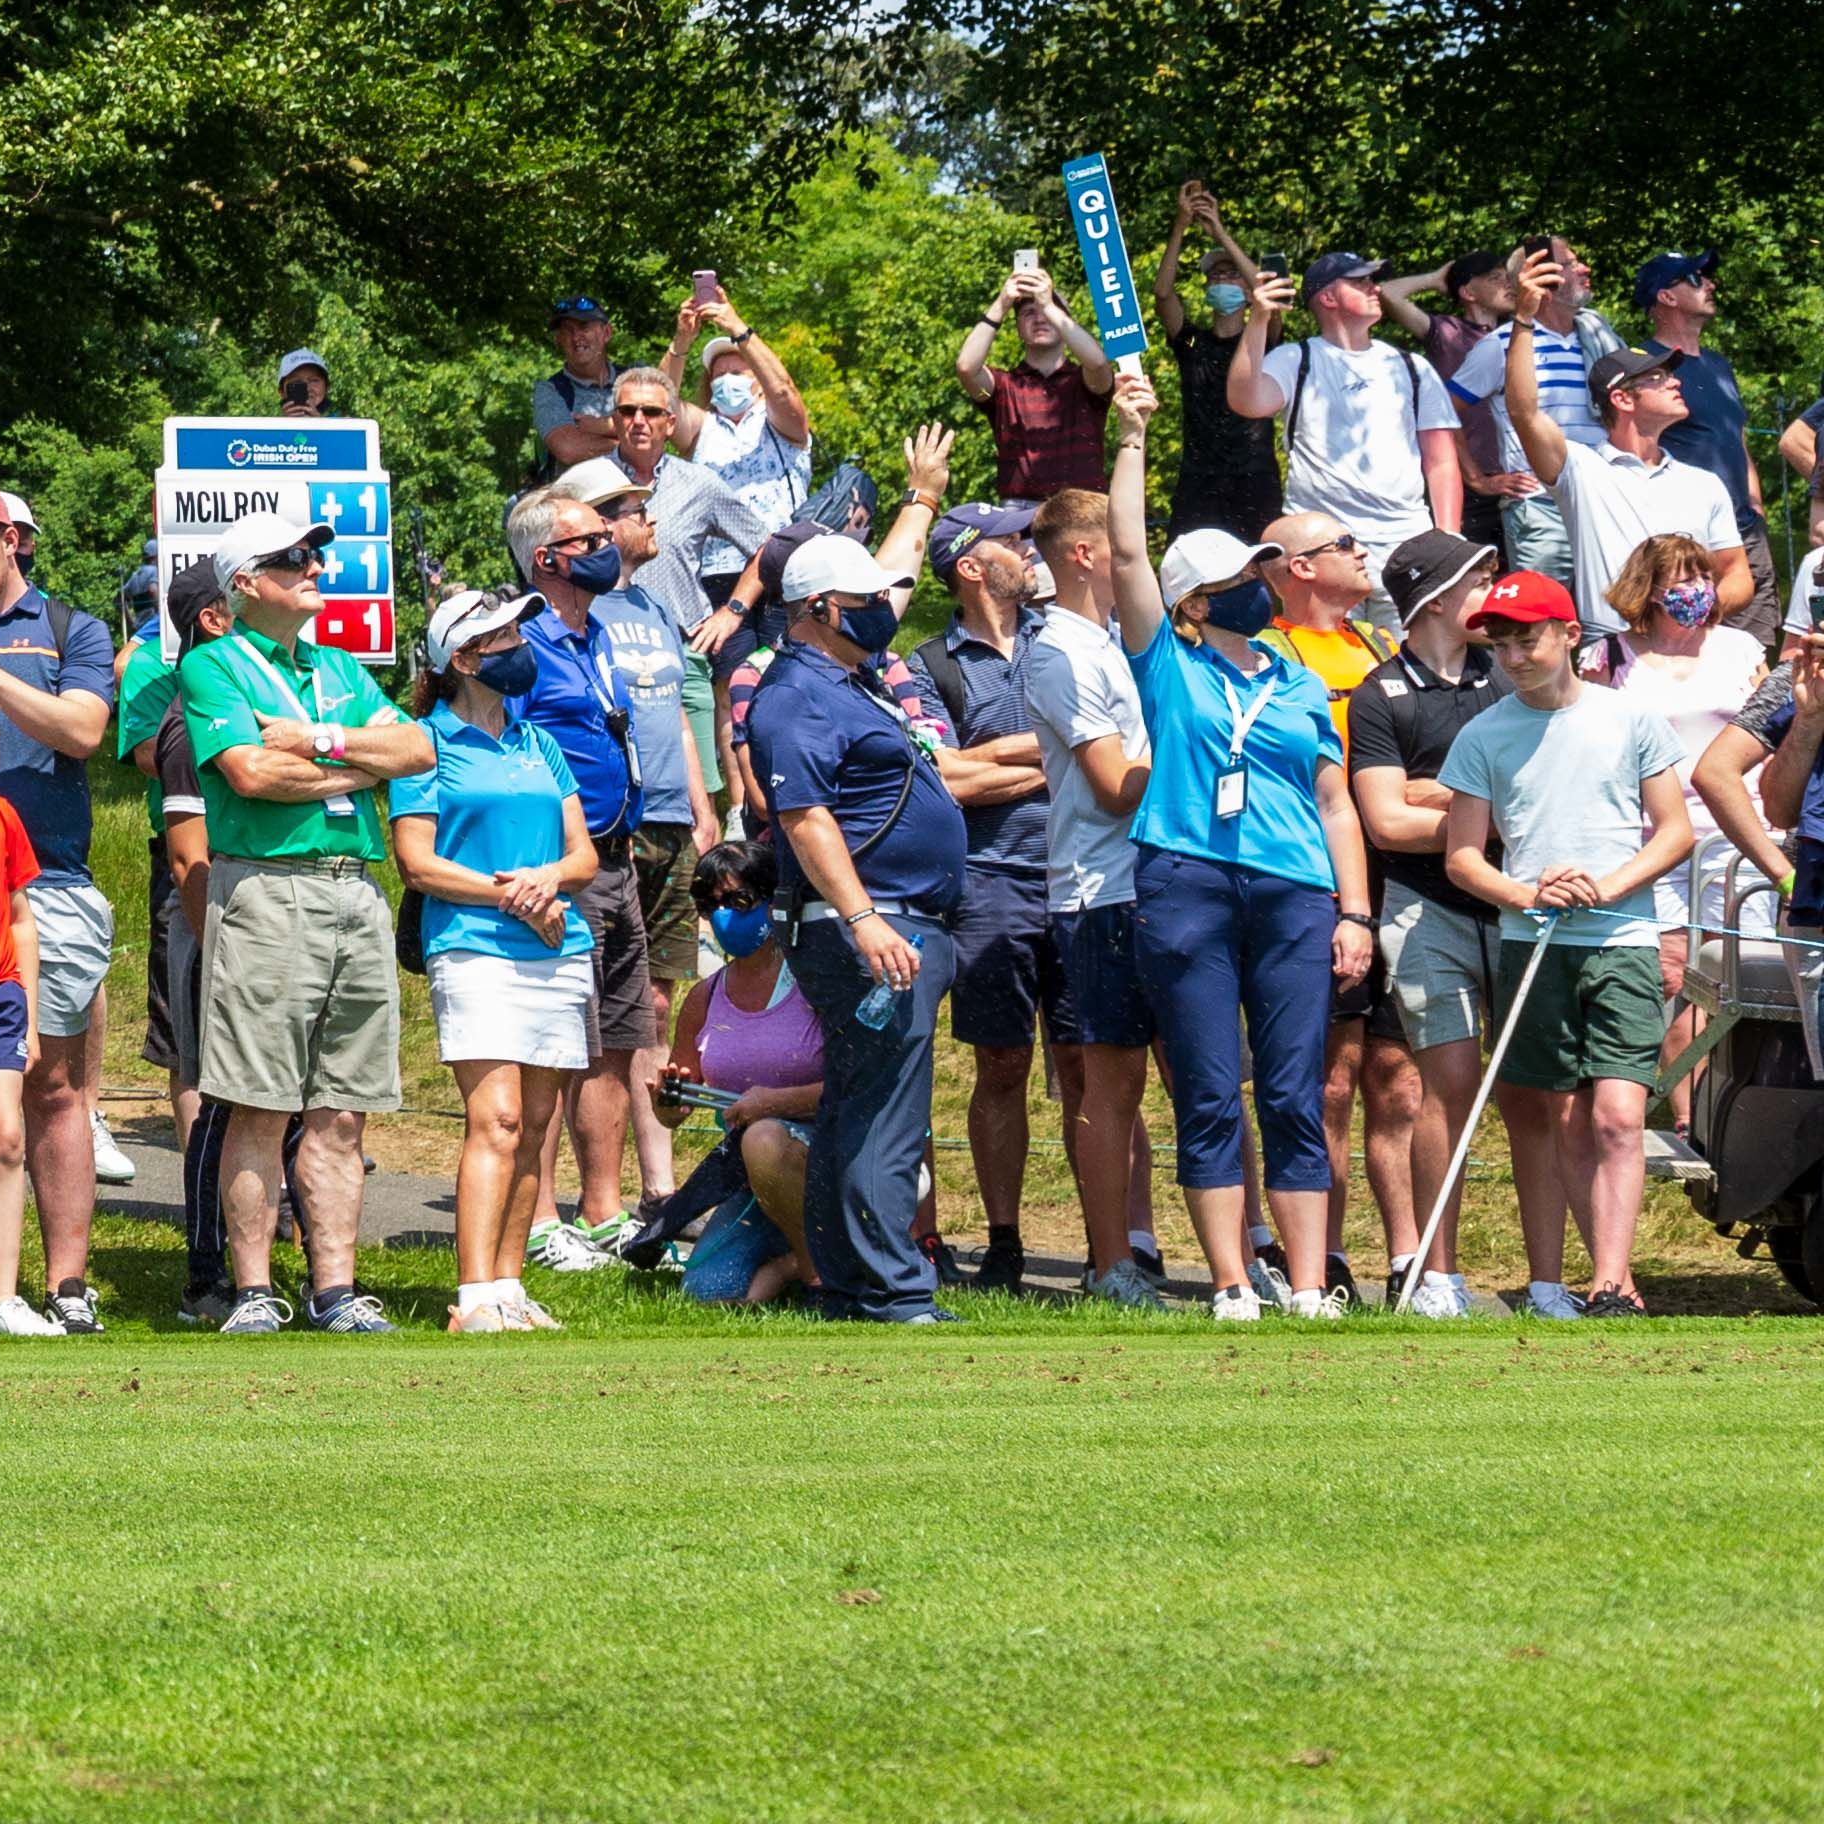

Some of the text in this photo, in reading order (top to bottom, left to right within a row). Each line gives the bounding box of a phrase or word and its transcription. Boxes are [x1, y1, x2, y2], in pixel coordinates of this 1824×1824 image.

[1078, 189, 1124, 318] QUIET
[1104, 323, 1139, 341] PLEASE
[278, 443, 298, 454] Duty
[299, 443, 318, 453] Free
[253, 453, 318, 463] IRISH OPEN
[175, 490, 279, 524] MCILROY
